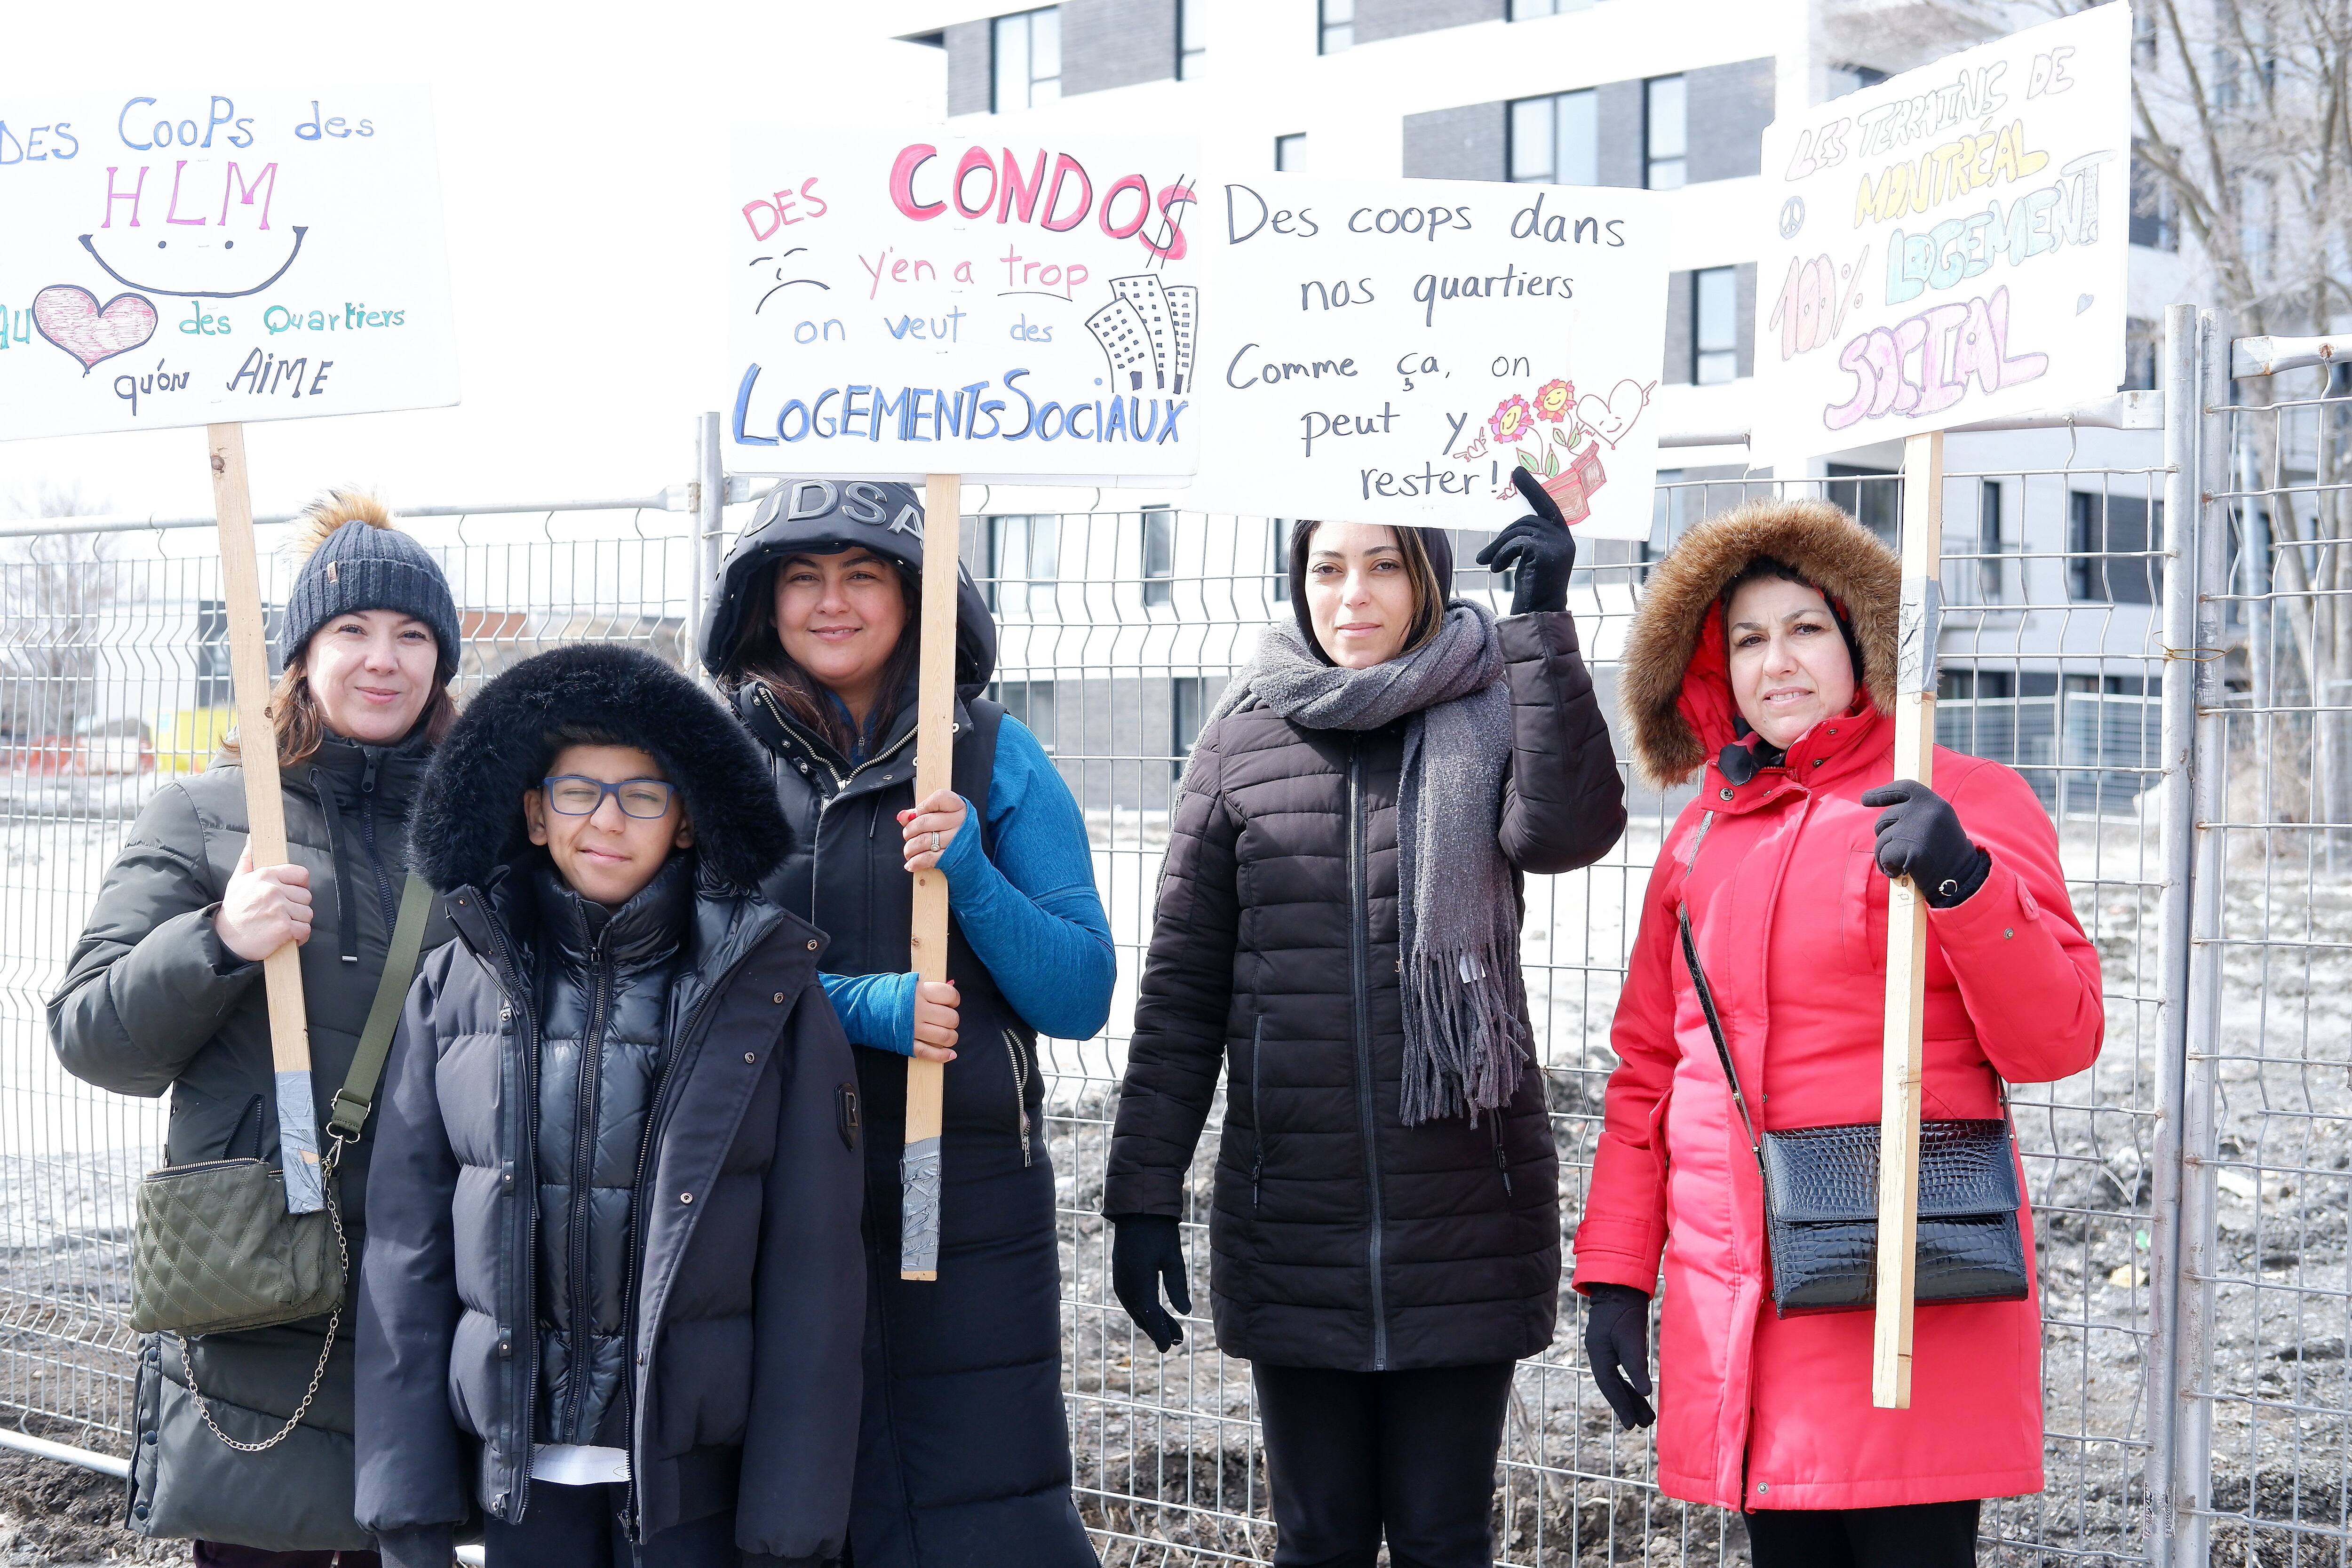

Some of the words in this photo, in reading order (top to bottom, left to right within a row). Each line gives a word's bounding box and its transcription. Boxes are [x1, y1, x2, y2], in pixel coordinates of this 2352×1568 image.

[0, 120, 79, 165] DES
[295, 101, 373, 140] des
[1786, 118, 1851, 181] LES
[1858, 61, 2008, 158] TERRAINS
[2027, 46, 2075, 100] DE
[101, 160, 278, 230] HLM
[1854, 116, 2049, 229] MONTRÉAL
[742, 177, 827, 241] DES
[1224, 184, 1318, 245] Des
[1349, 207, 1471, 241] coops
[1511, 192, 1624, 247] dans
[1885, 149, 2117, 306] LOGEMENT
[954, 261, 974, 284] a
[1000, 244, 1088, 301] trop
[1301, 278, 1374, 310] nos
[1414, 264, 1573, 327] quartiers
[179, 301, 231, 335] des
[264, 302, 405, 335] Quartiers
[795, 319, 845, 344] on
[884, 306, 966, 342] veut
[1010, 313, 1053, 342] des
[1227, 343, 1358, 389] Comme
[1397, 353, 1449, 391] ça,
[1492, 357, 1529, 377] on
[1823, 285, 2049, 431] SOCIAL
[1301, 402, 1400, 457] peut
[1361, 460, 1499, 500] rester!
